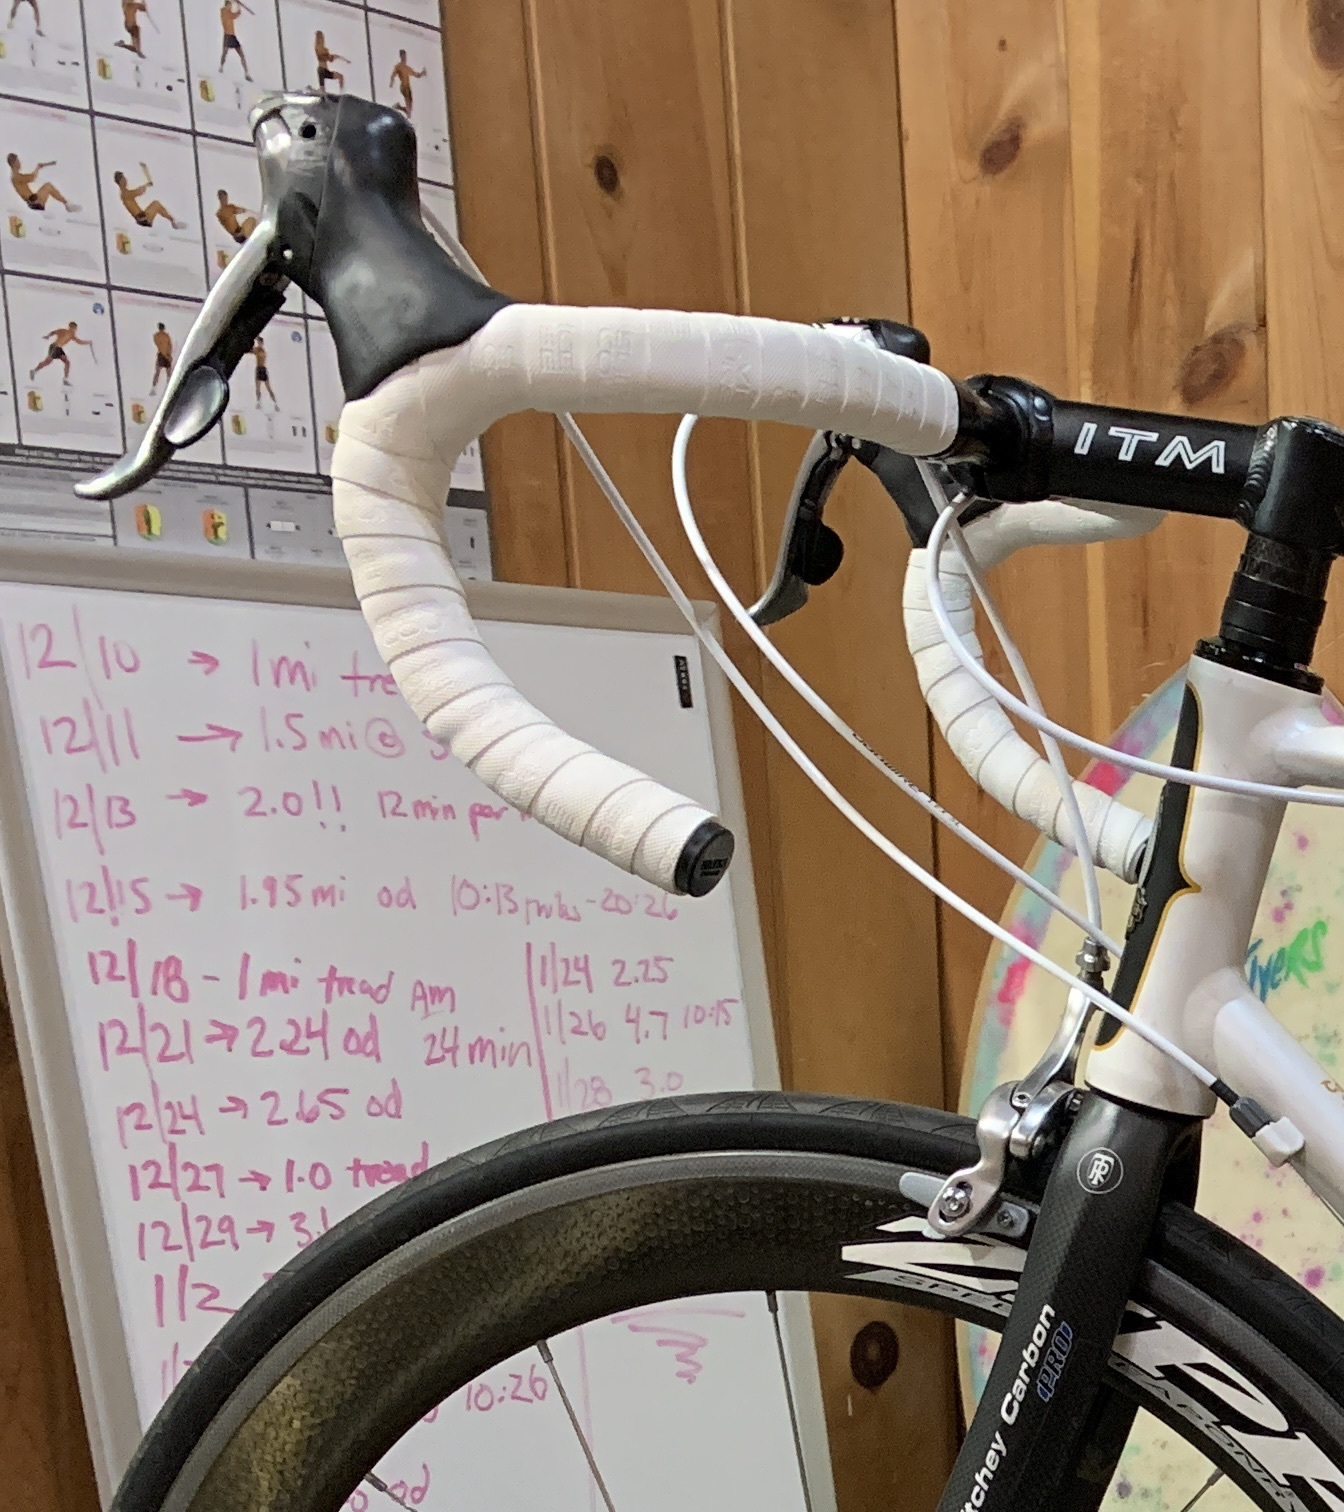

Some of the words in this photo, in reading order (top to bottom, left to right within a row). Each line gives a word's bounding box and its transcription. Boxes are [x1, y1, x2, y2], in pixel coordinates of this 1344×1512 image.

[1074, 422, 1226, 475] ITM
[340, 650, 400, 698] tre
[87, 938, 190, 1003] 12/18
[611, 954, 674, 988] 2.25
[128, 1140, 226, 1202] 12/27
[138, 1202, 240, 1263] 12/29
[466, 1364, 548, 1412] 10:26
[1000, 1303, 1057, 1427] Carbon
